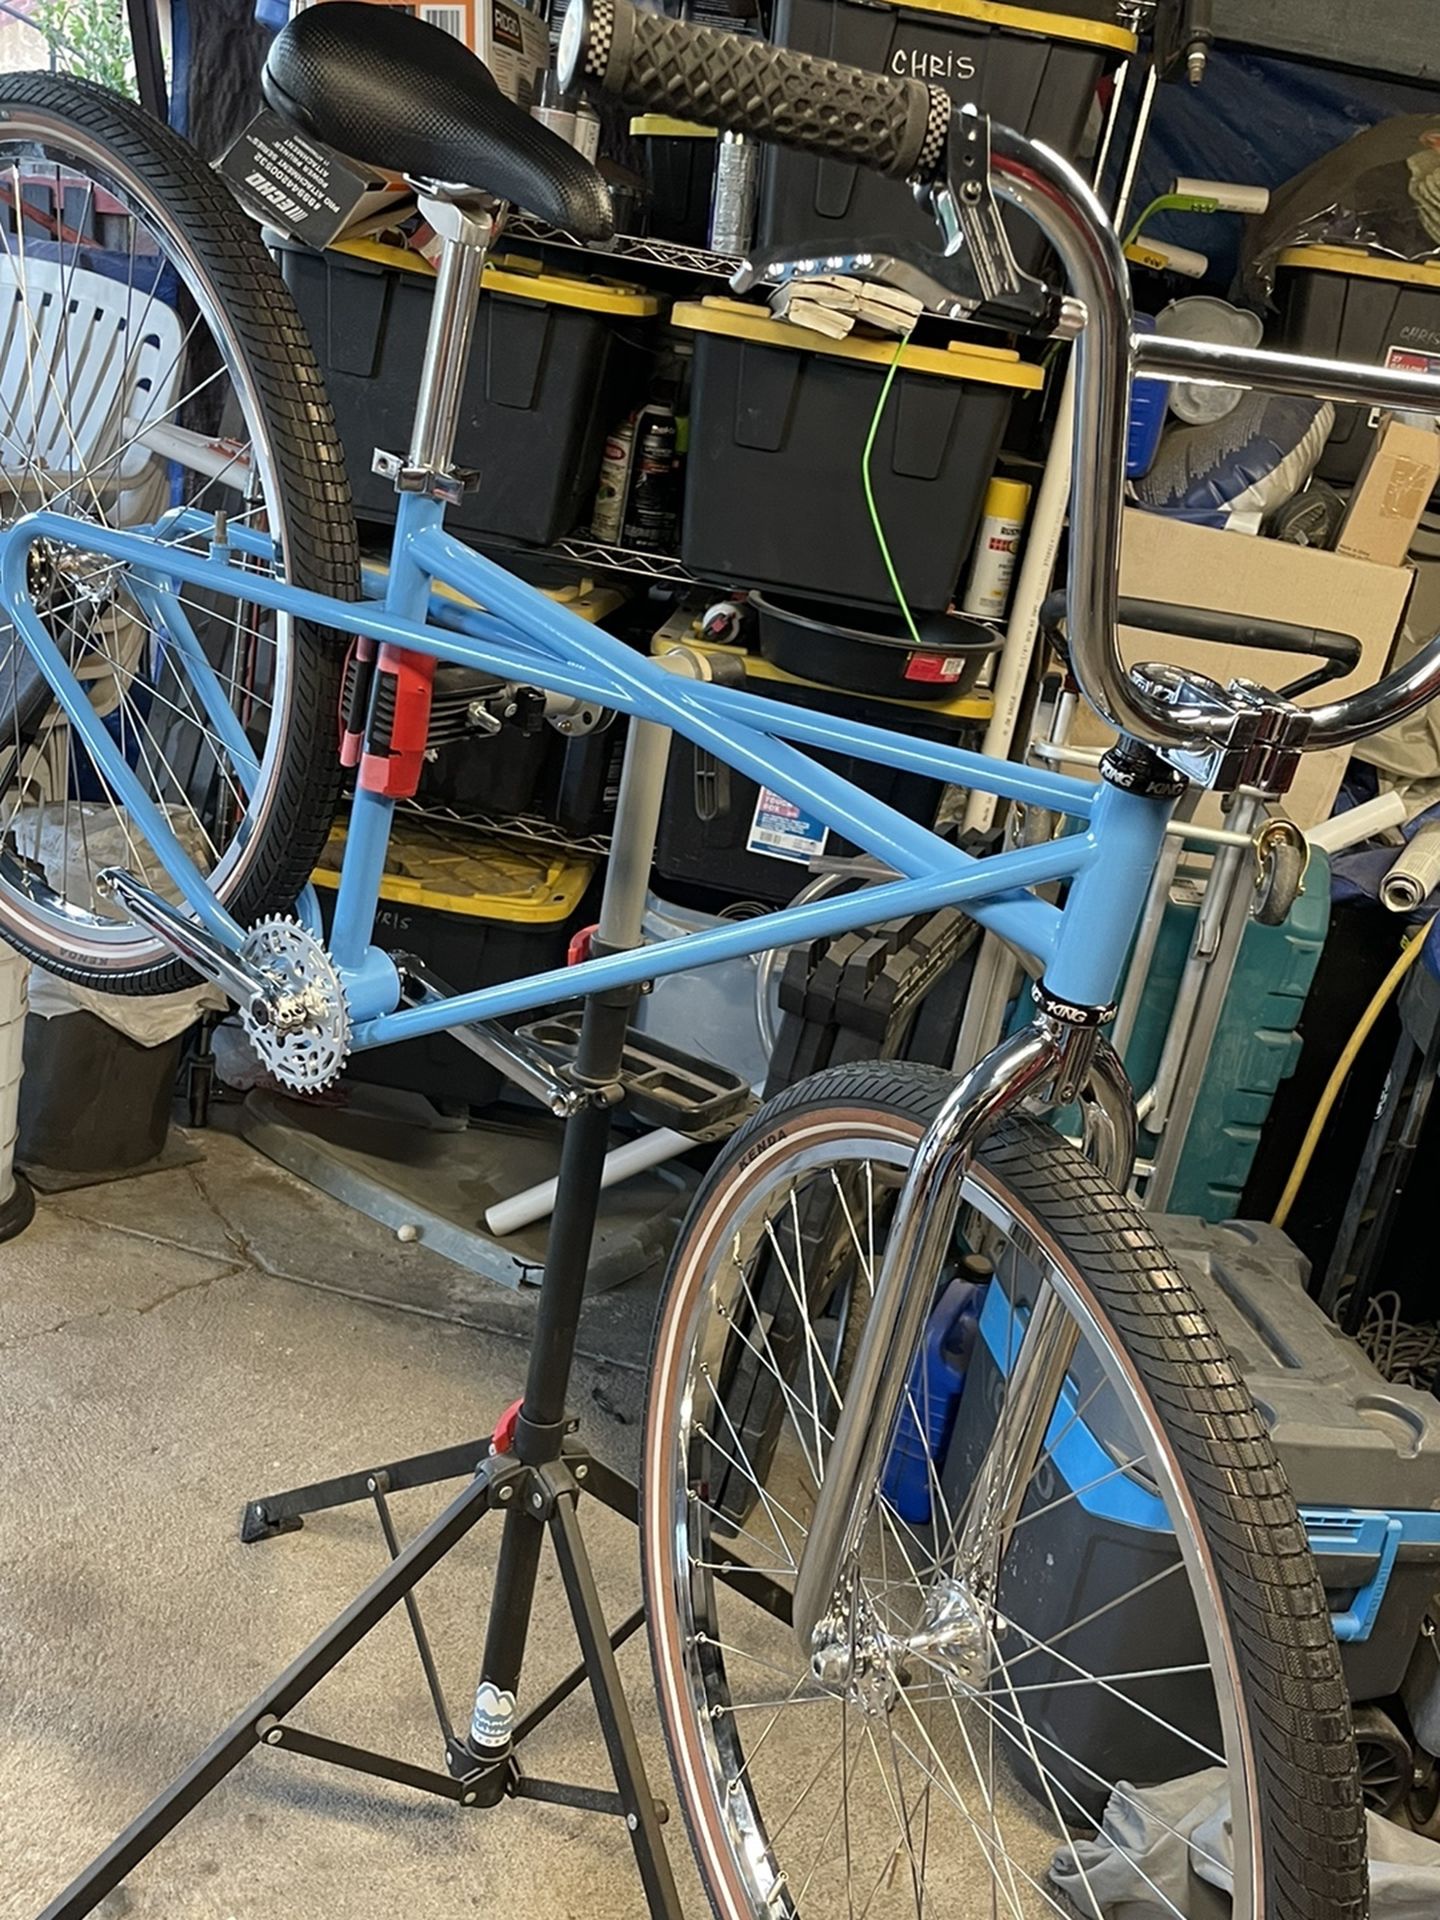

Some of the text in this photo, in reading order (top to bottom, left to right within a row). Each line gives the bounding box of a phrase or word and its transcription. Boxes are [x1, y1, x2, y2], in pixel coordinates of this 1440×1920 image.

[302, 164, 329, 189] POWER
[245, 172, 296, 212] ECHO
[323, 197, 341, 213] PRO
[1400, 325, 1440, 345] CHRIS
[1101, 758, 1184, 797] KING KING
[59, 947, 109, 966] KENDA
[1046, 1000, 1088, 1023] KING
[739, 1129, 788, 1172] KENDA
